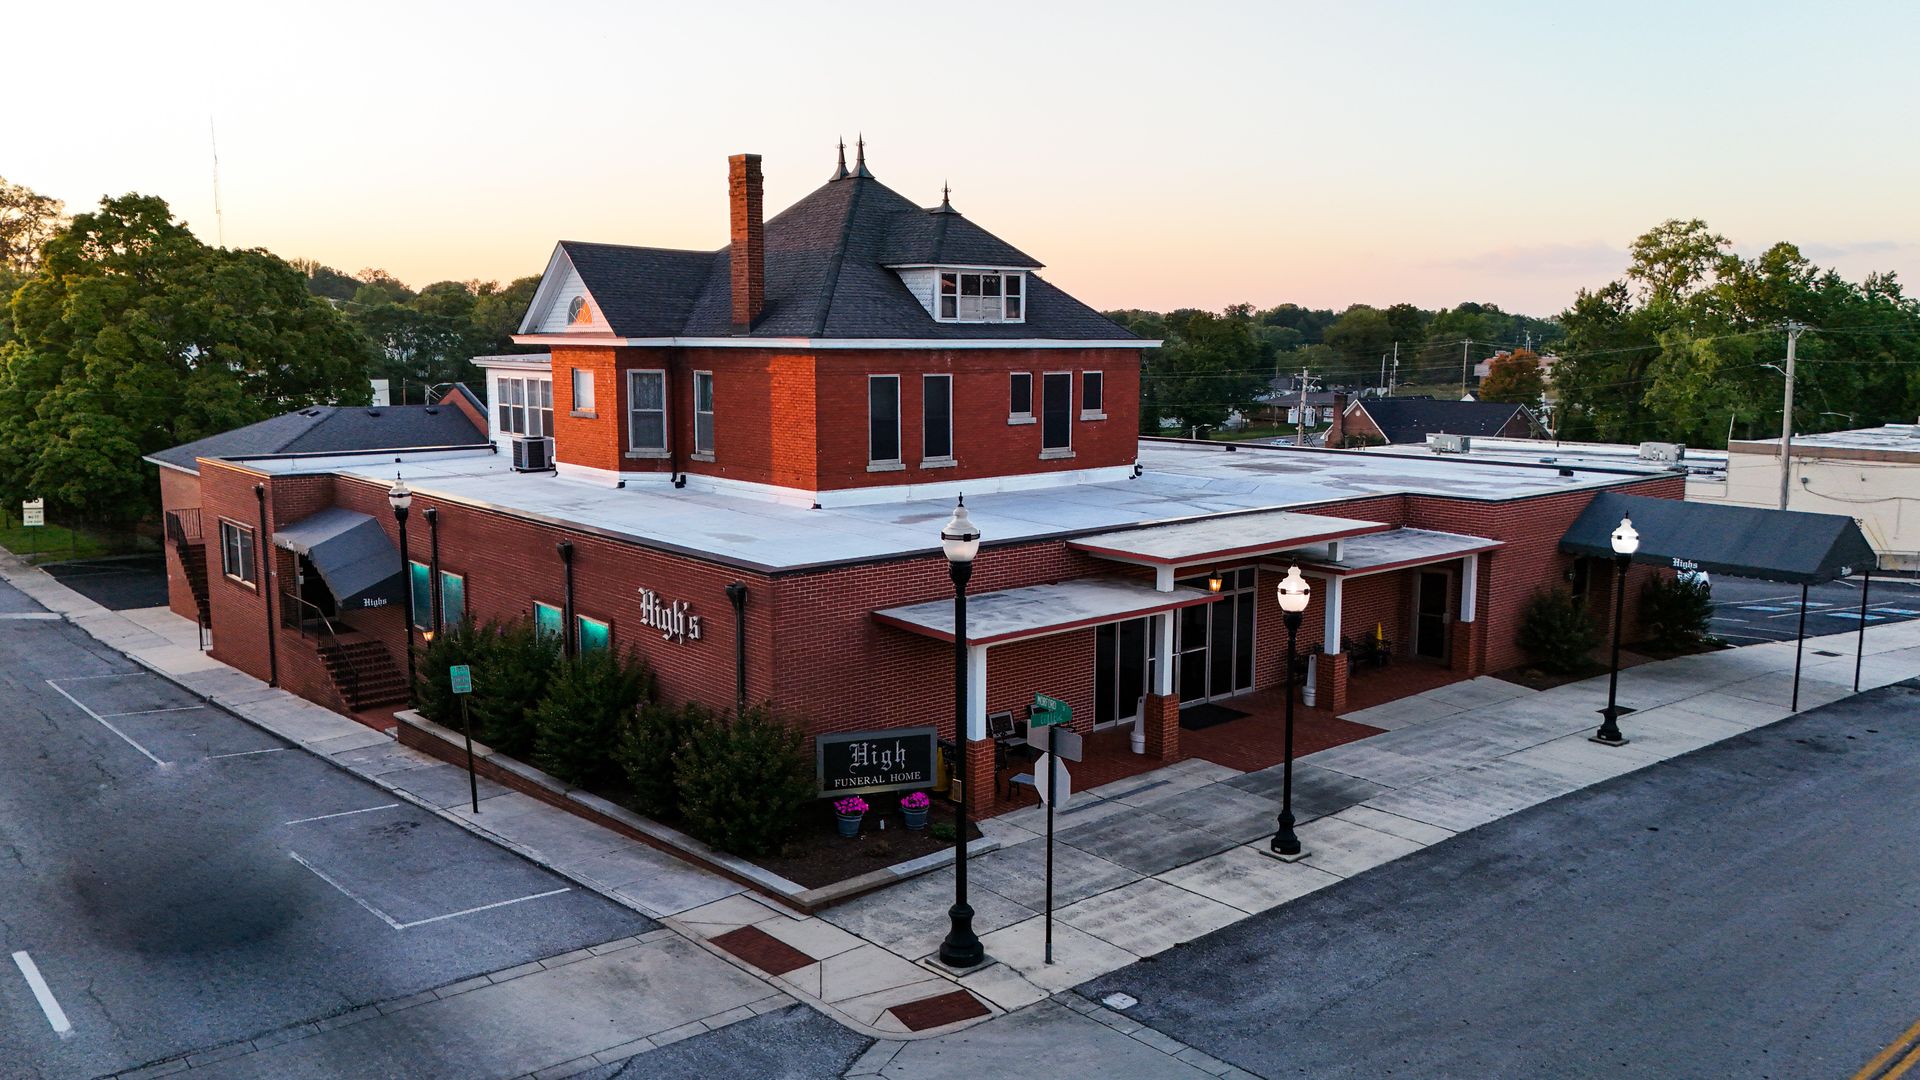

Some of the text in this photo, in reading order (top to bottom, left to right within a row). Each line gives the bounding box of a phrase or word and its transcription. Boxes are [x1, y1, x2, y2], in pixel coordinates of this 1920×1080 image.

[638, 587, 700, 645] High's
[849, 740, 906, 774] High
[834, 771, 921, 788] FUNERAL HOME
